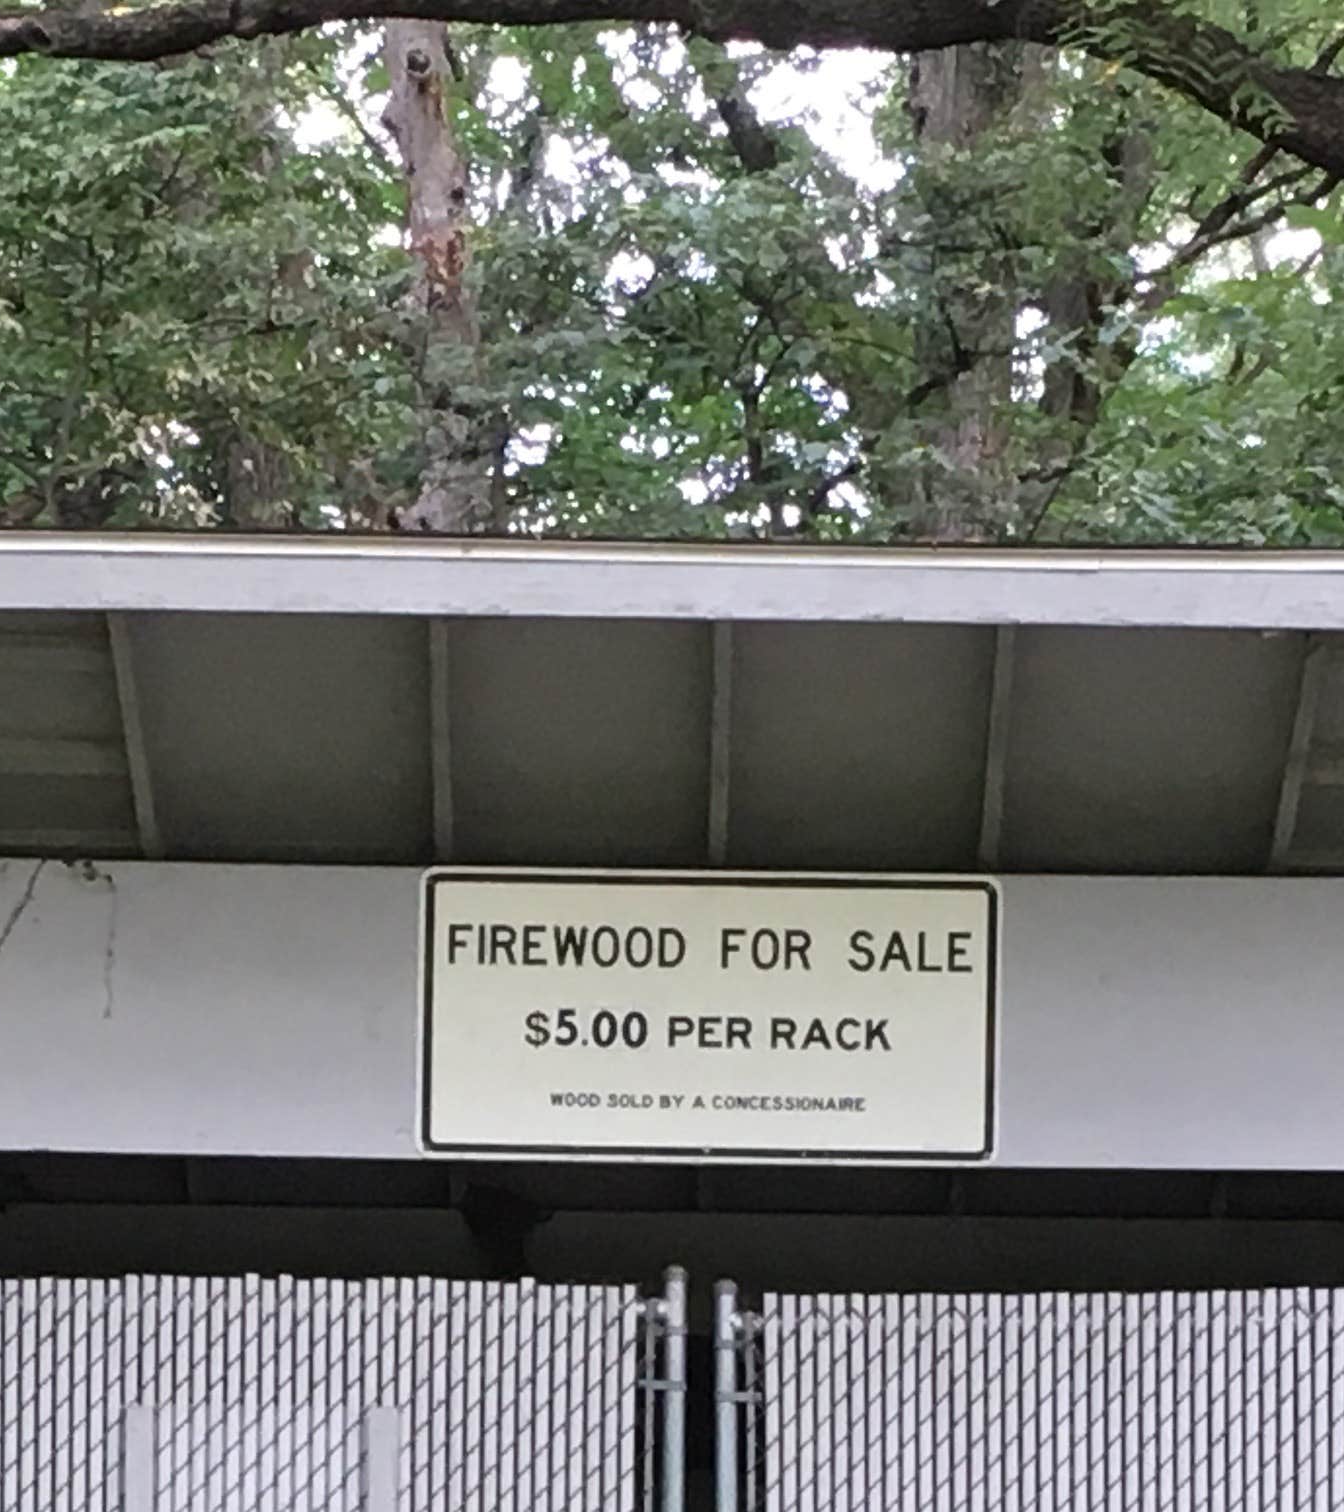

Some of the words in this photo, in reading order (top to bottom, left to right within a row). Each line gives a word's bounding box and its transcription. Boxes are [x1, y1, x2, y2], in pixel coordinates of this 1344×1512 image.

[447, 924, 686, 969] FIREWOOD
[720, 927, 813, 971] FOR
[847, 930, 973, 973] SALE
[524, 1008, 649, 1049] $5.00
[667, 1016, 753, 1049] PER
[769, 1017, 892, 1051] RACK
[550, 1092, 602, 1108] WOOD
[606, 1093, 654, 1109] SOLD
[659, 1094, 684, 1109] BY
[691, 1095, 707, 1109] A
[711, 1095, 867, 1112] CONCESSIONAIRE
